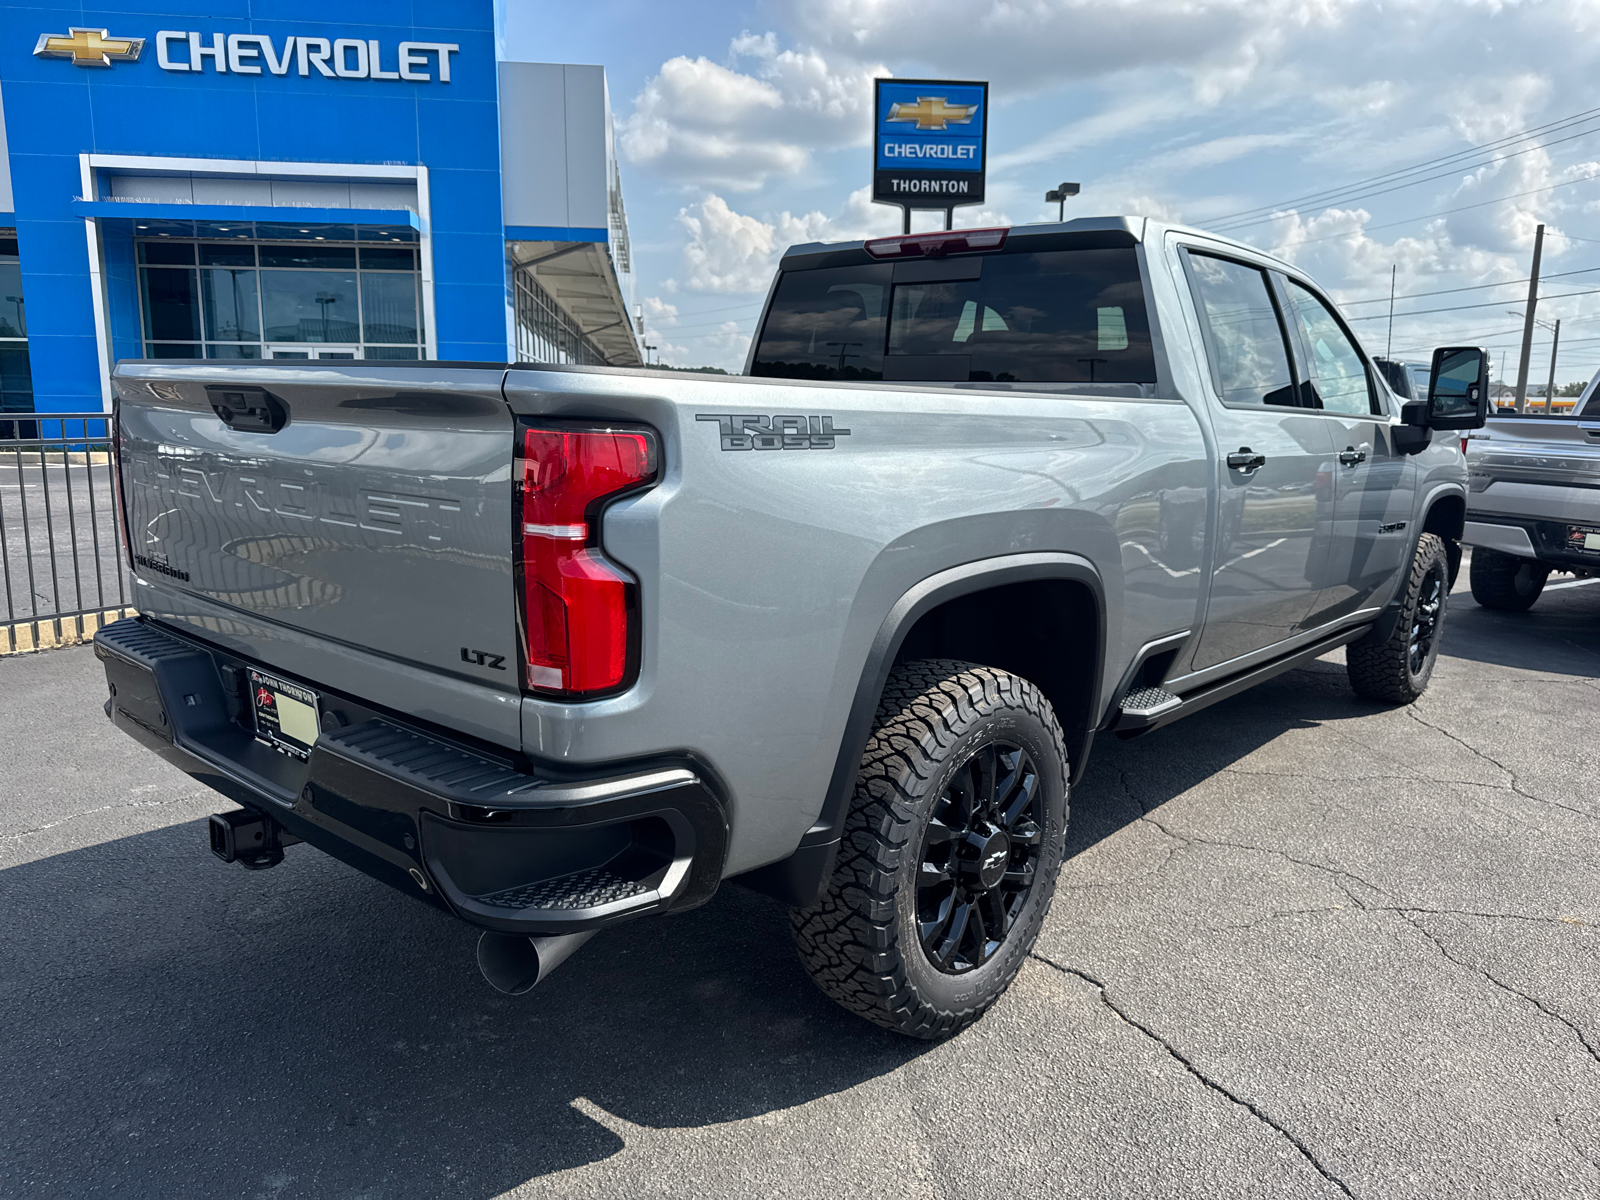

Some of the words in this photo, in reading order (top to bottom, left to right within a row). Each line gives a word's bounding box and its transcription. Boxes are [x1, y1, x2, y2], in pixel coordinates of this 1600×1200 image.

[155, 30, 460, 83] CHEVROLET
[884, 143, 977, 159] CHEVROLET
[891, 179, 969, 193] THORNTON
[695, 413, 851, 435] TRAIL
[720, 434, 836, 451] BOSS
[460, 647, 507, 671] LTZ
[262, 675, 279, 689] JOHN
[279, 682, 313, 704] THORNTON
